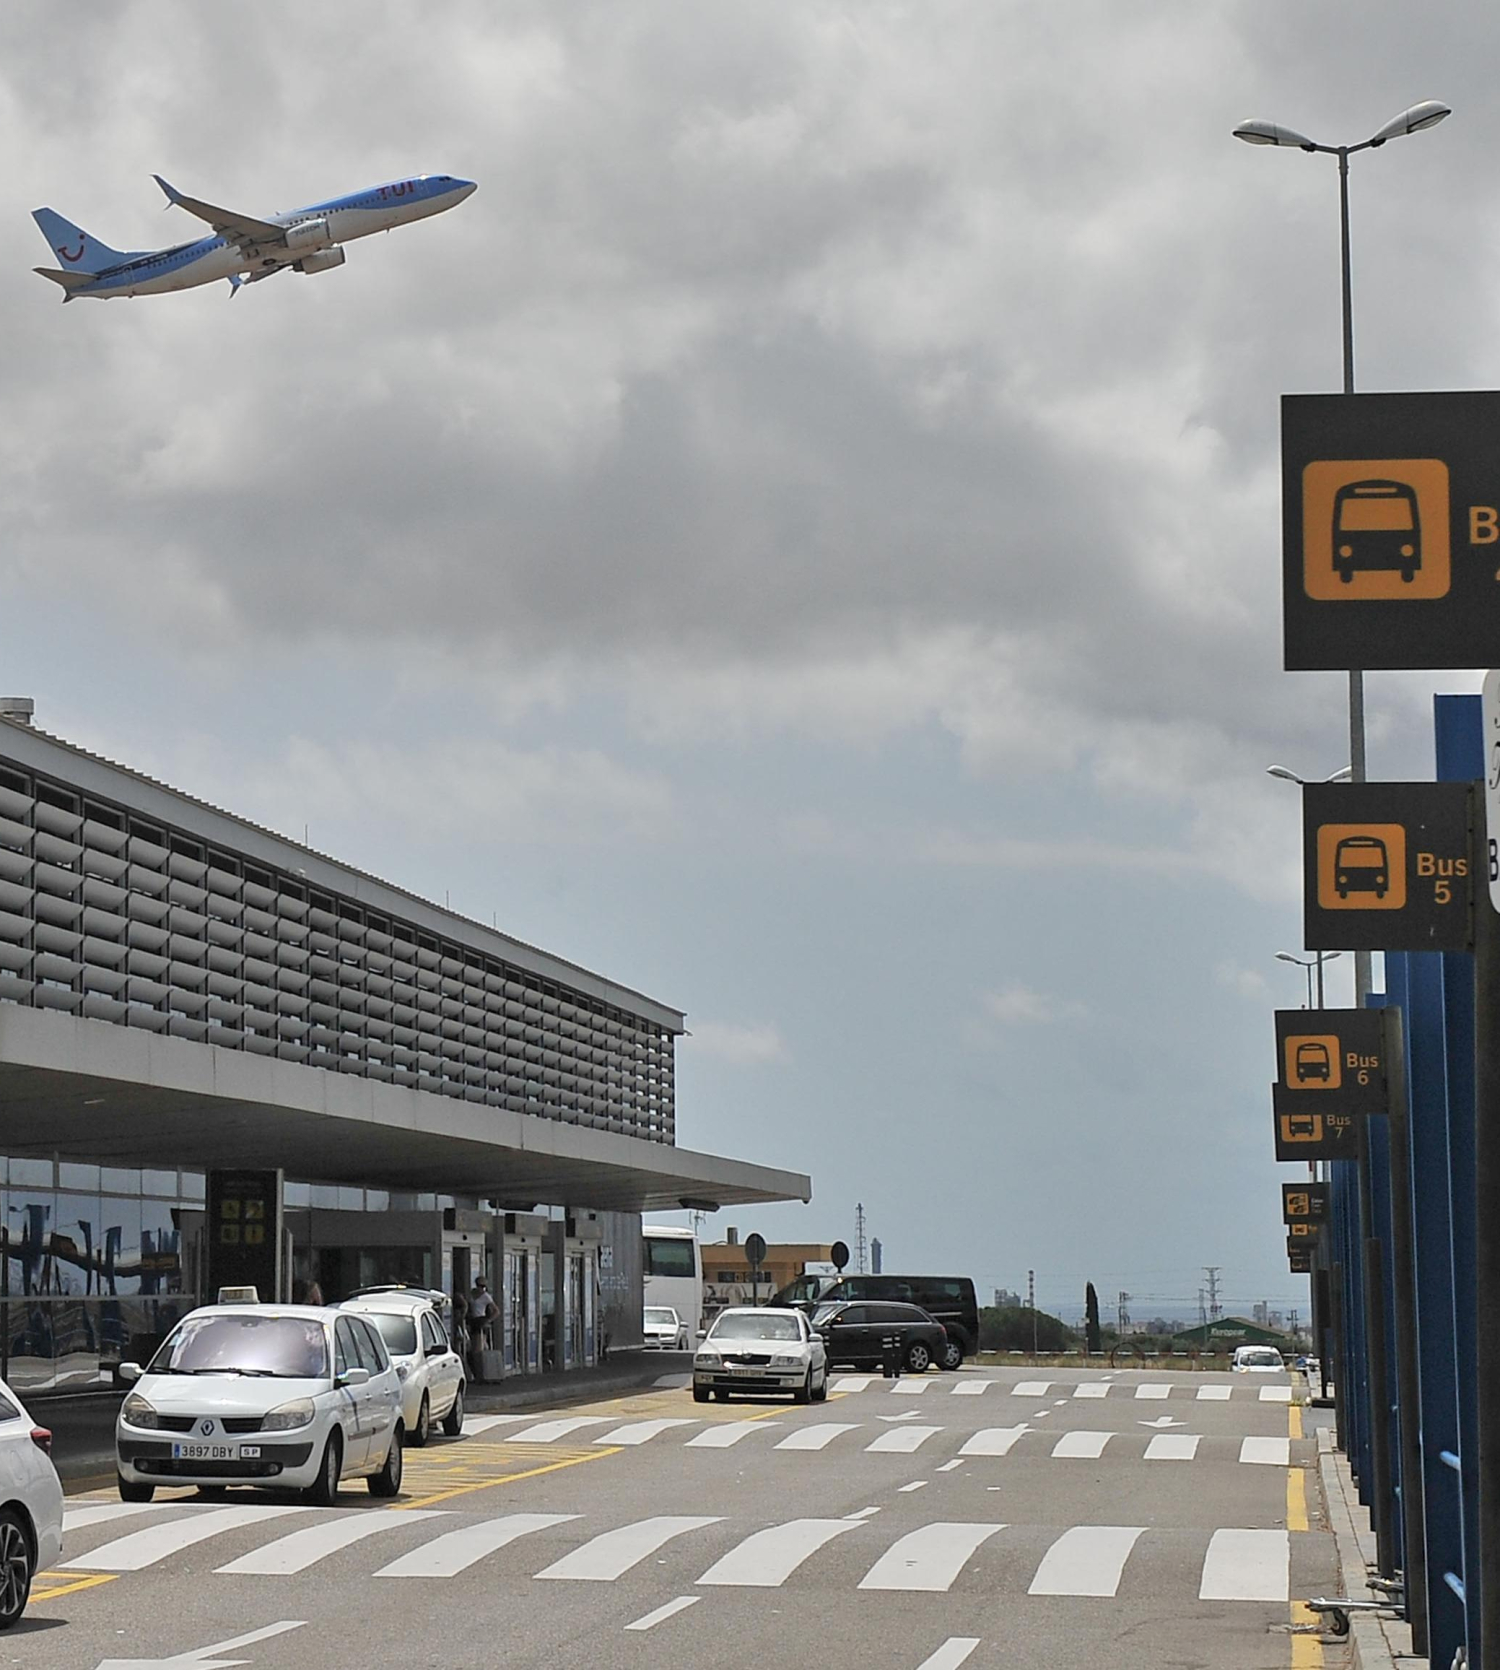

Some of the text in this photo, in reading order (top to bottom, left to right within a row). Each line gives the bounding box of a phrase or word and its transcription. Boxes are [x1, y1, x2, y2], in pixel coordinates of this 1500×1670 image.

[376, 180, 414, 200] TUI
[1417, 852, 1468, 877] Bus
[1433, 880, 1452, 905] 5
[1346, 1052, 1378, 1068] Bus
[1357, 1070, 1369, 1085] 6
[1327, 1114, 1351, 1126] Bus
[1335, 1127, 1343, 1138] 7
[182, 1446, 234, 1458] 3897 DBY
